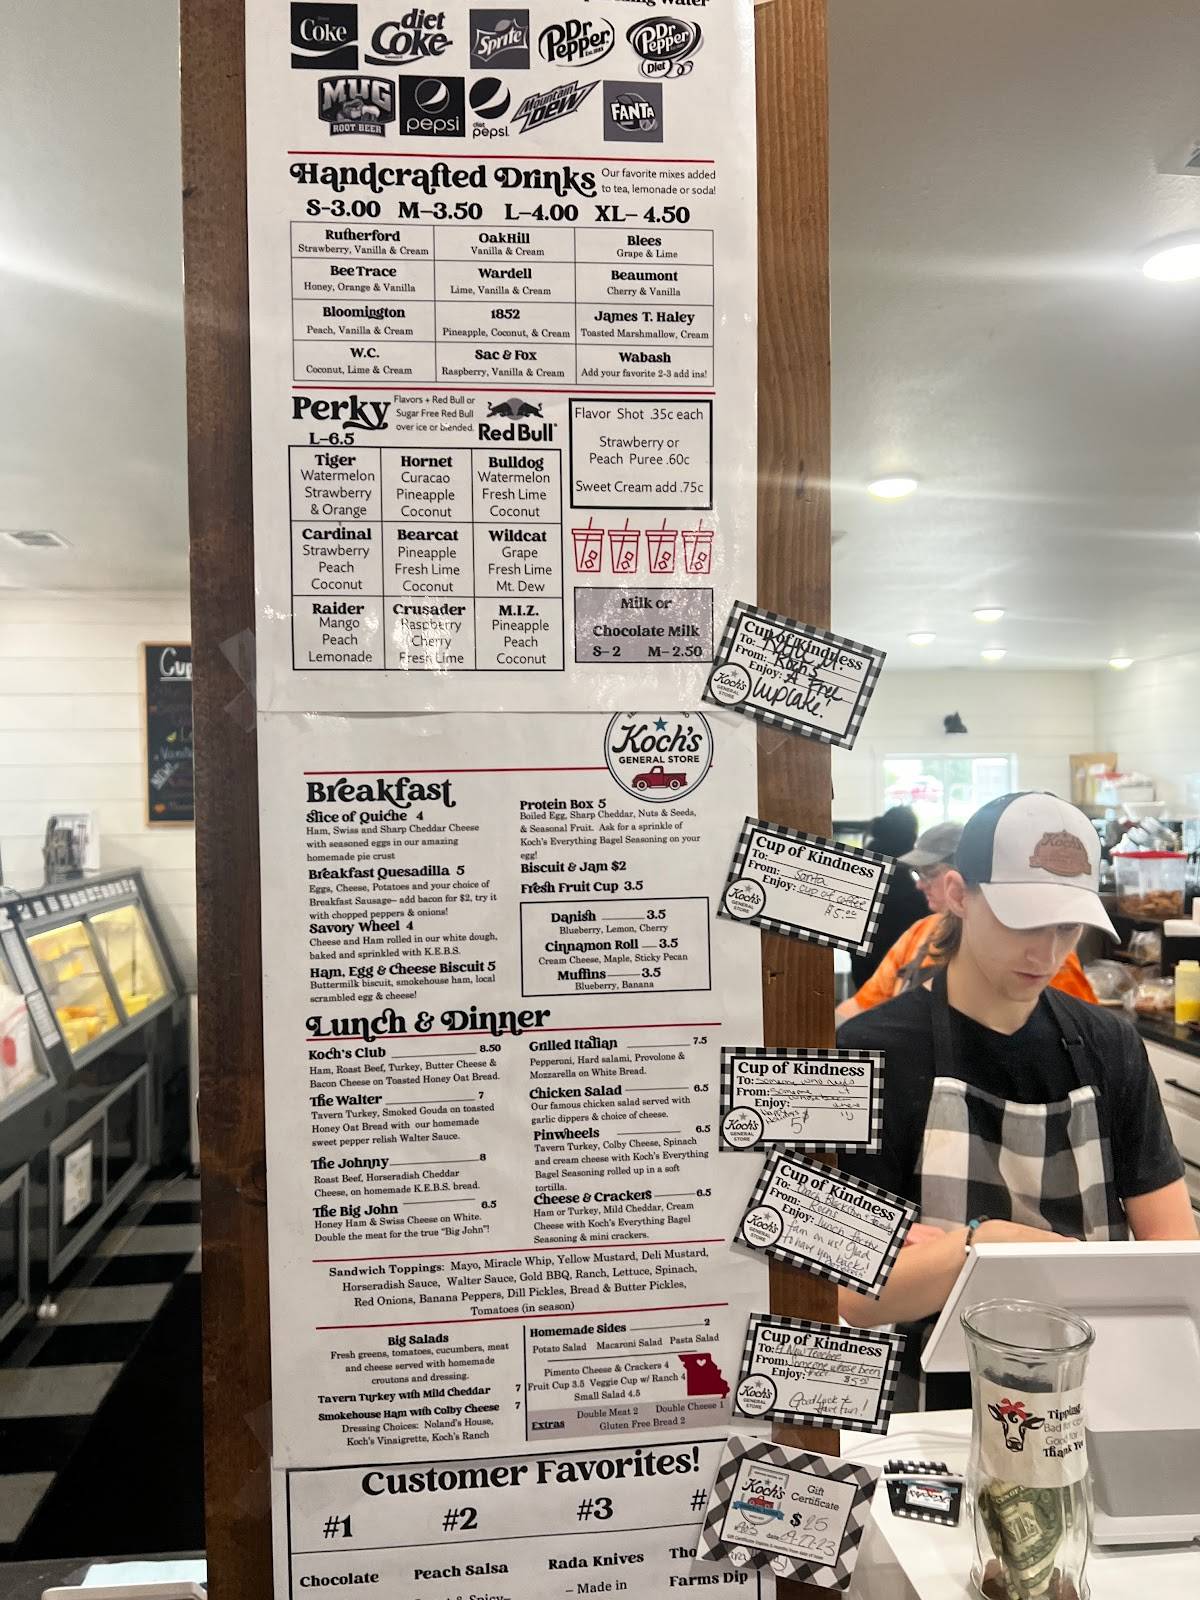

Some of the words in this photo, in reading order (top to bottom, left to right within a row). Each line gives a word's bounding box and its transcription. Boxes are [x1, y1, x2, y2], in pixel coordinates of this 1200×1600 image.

[401, 7, 445, 31] diet
[299, 17, 347, 43] Coke
[565, 18, 591, 42] Dr
[654, 21, 677, 39] Dr
[371, 20, 453, 57] Coke
[477, 28, 523, 57] Sprite
[543, 25, 611, 62] Pepper
[637, 28, 690, 54] Pepper
[646, 60, 666, 74] Diet
[321, 78, 393, 113] MUG
[610, 101, 656, 121] FANTA
[331, 124, 356, 135] ROOT
[357, 124, 382, 135] BEER
[406, 115, 460, 133] pepsi
[471, 125, 508, 139] pepsi
[289, 162, 488, 195] Handcrafted
[494, 166, 597, 198] Drinks
[601, 168, 620, 177] Our
[622, 168, 657, 178] favorite
[659, 170, 685, 179] mixes
[687, 169, 716, 179] added
[601, 185, 611, 193] to
[613, 185, 630, 194] tea,
[632, 184, 677, 194] lemonade
[692, 185, 716, 195] soda!
[306, 199, 381, 218] S-3.00
[398, 201, 483, 220] M-3.50
[504, 203, 579, 221] L-4.00
[643, 205, 690, 224] 4.50
[325, 228, 401, 242] Rutherford
[627, 235, 662, 246] Blees
[298, 243, 352, 255] Strawberry,
[354, 245, 387, 255] Vanilla
[389, 246, 397, 255] &
[399, 246, 429, 255] Cream
[616, 249, 643, 259] Grape
[645, 249, 653, 258] &
[656, 249, 678, 258] Lime
[478, 268, 532, 279] Wardell
[611, 270, 678, 281] Beaumont
[323, 305, 406, 320] Bloomington
[491, 308, 520, 319] 1852
[594, 311, 638, 324] James
[642, 312, 653, 322] T.
[657, 311, 695, 326] Haley
[350, 348, 380, 358] W.C.
[475, 349, 500, 360] Sac
[502, 350, 512, 360] &
[515, 350, 537, 360] Fox
[619, 352, 671, 363] Wabash
[292, 395, 391, 431] Perky
[477, 422, 518, 443] Red
[518, 423, 554, 443] Bull
[314, 452, 356, 469] Tiger
[401, 456, 453, 467] Hornet
[488, 456, 544, 472] Bulldog
[300, 469, 375, 481] Watermelon
[576, 480, 611, 492] Sweet
[614, 481, 652, 493] Cream
[655, 481, 677, 493] add
[680, 481, 704, 493] .75c
[302, 527, 372, 540] Cardinal
[397, 529, 459, 541] Bearcat
[488, 528, 547, 542] Wildcat
[312, 601, 365, 615] Raider
[393, 603, 466, 616] Crusader
[499, 605, 539, 616] M.I.Z.
[620, 596, 653, 609] Milk
[655, 599, 672, 609] or
[593, 625, 665, 637] Chocolate
[668, 624, 700, 637] Milk
[743, 619, 774, 642] Cup
[735, 644, 768, 663] From:
[748, 660, 783, 680] Enjoy:
[611, 724, 704, 755] Koch's
[619, 756, 665, 764] GENERAL
[668, 755, 700, 763] STORE
[306, 777, 456, 809] Breakfast
[520, 798, 567, 810] Protein
[570, 799, 594, 809] Box
[598, 798, 606, 809] 5
[306, 809, 339, 823] Slice
[341, 810, 357, 822] of
[359, 809, 407, 825] Quiche
[416, 811, 423, 821] 4
[755, 836, 786, 855] Cup
[788, 844, 806, 859] of
[808, 850, 875, 879] Kindness
[521, 861, 565, 873] Biscuit
[567, 862, 577, 872] &
[579, 862, 608, 873] Jam
[611, 860, 627, 872] $2
[747, 859, 780, 876] From:
[762, 874, 797, 891] Enjoy:
[551, 909, 596, 924] Danish
[646, 909, 666, 920] 3.5
[559, 926, 603, 935] Blueberry,
[606, 925, 637, 933] Lemon,
[639, 923, 668, 933] Cherry
[557, 968, 606, 981] Muffins
[641, 967, 661, 978] 3.5
[305, 1008, 407, 1042] Lunch
[414, 1011, 435, 1033] &
[440, 1006, 551, 1036] Dinner
[529, 1039, 572, 1052] Grilled
[574, 1035, 618, 1050] Italian
[693, 1036, 707, 1045] 7.5
[308, 1047, 352, 1060] Koch's
[355, 1047, 386, 1058] Club
[479, 1044, 501, 1053] 8.50
[738, 1060, 769, 1077] Cup
[772, 1061, 791, 1075] of
[793, 1062, 865, 1077] Kindness
[735, 1087, 771, 1097] From:
[725, 1119, 760, 1132] Koch's
[769, 1187, 802, 1206] From:
[780, 1164, 809, 1186] Cup
[810, 1175, 828, 1192] of
[829, 1180, 895, 1222] Kindness
[781, 1203, 816, 1224] Enjoy:
[329, 1265, 386, 1277] Sandwich
[388, 1263, 444, 1275] Toppings:
[450, 1261, 481, 1271] Mayo,
[484, 1257, 522, 1269] Miracle
[524, 1256, 554, 1267] Whip,
[557, 1254, 591, 1264] Yellow
[593, 1251, 638, 1262] Mustard,
[641, 1250, 662, 1260] Deli
[664, 1247, 709, 1259] Mustard,
[530, 1325, 594, 1338] Homemade
[596, 1323, 627, 1334] Sides
[704, 1318, 710, 1326] 2
[388, 1335, 406, 1348] Big
[410, 1333, 449, 1345] Salads
[760, 1329, 791, 1346] Cup
[793, 1331, 813, 1346] of
[813, 1336, 883, 1358] Kindness
[755, 1353, 789, 1367] From:
[771, 1367, 806, 1380] Enjoy:
[739, 1383, 773, 1399] Koch's
[532, 1421, 565, 1431] Extras
[362, 1465, 528, 1496] Customer
[536, 1446, 701, 1485] Favorites!
[740, 1476, 787, 1502] Koch's
[806, 1483, 826, 1497] Gift
[790, 1491, 841, 1512] Certificate
[323, 1514, 353, 1539] #1
[442, 1507, 478, 1532] #2
[577, 1497, 613, 1521] #3
[549, 1557, 588, 1570] Rada
[593, 1552, 644, 1567] Knives
[414, 1565, 461, 1580] Peach
[465, 1562, 509, 1576] Salsa
[669, 1575, 719, 1587] Farms
[723, 1569, 748, 1585] Dip
[300, 1573, 379, 1587] Chocolate
